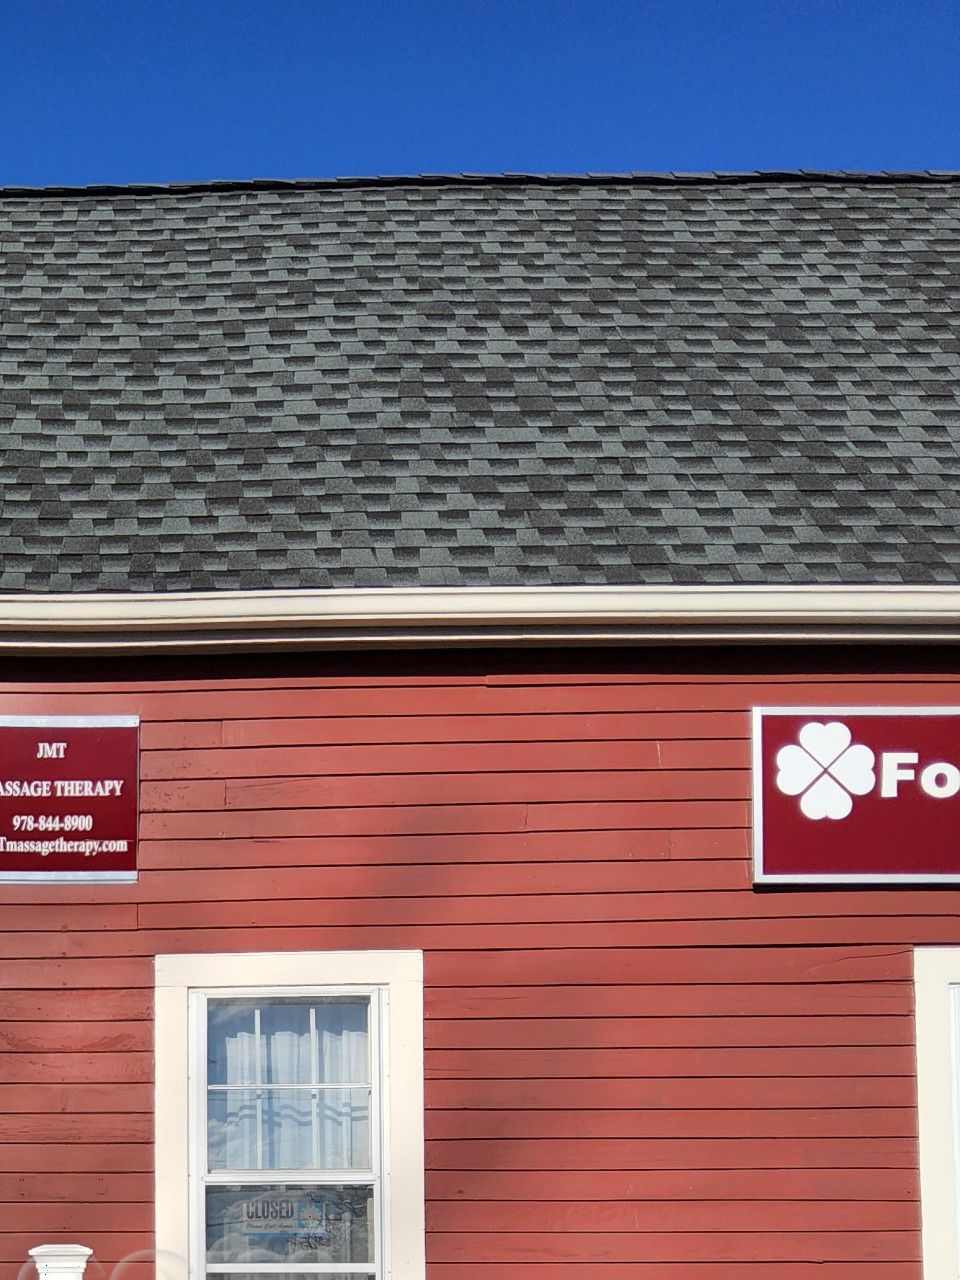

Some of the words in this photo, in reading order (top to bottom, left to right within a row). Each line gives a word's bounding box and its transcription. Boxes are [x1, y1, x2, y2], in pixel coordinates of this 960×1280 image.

[36, 742, 67, 758] JMT
[54, 780, 124, 797] THERAPY
[12, 815, 93, 831] 978-844-8900
[246, 1200, 295, 1220] CLOSED
